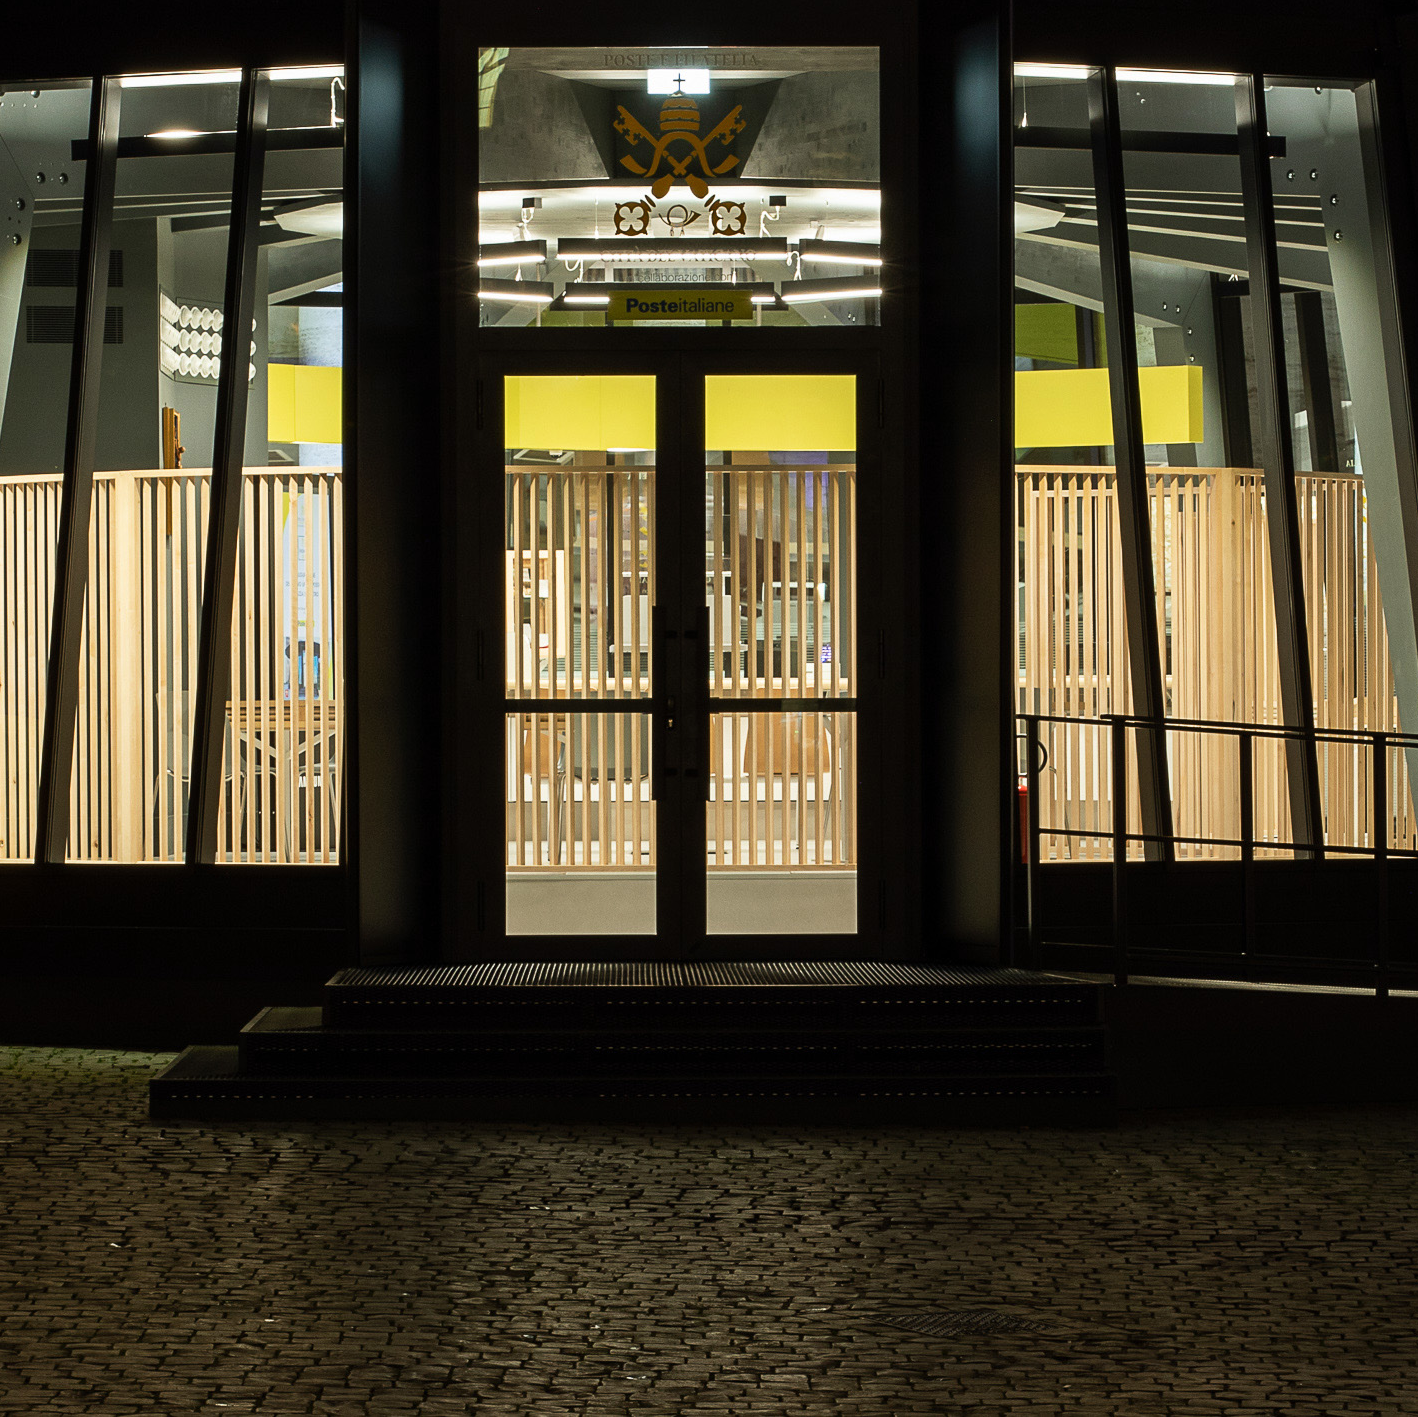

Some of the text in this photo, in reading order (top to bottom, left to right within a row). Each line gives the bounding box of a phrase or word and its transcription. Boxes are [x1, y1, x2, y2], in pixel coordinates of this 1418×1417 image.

[604, 54, 652, 66] POSTE
[675, 53, 758, 66] FILATELIA
[626, 297, 734, 313] Posteitaliane
